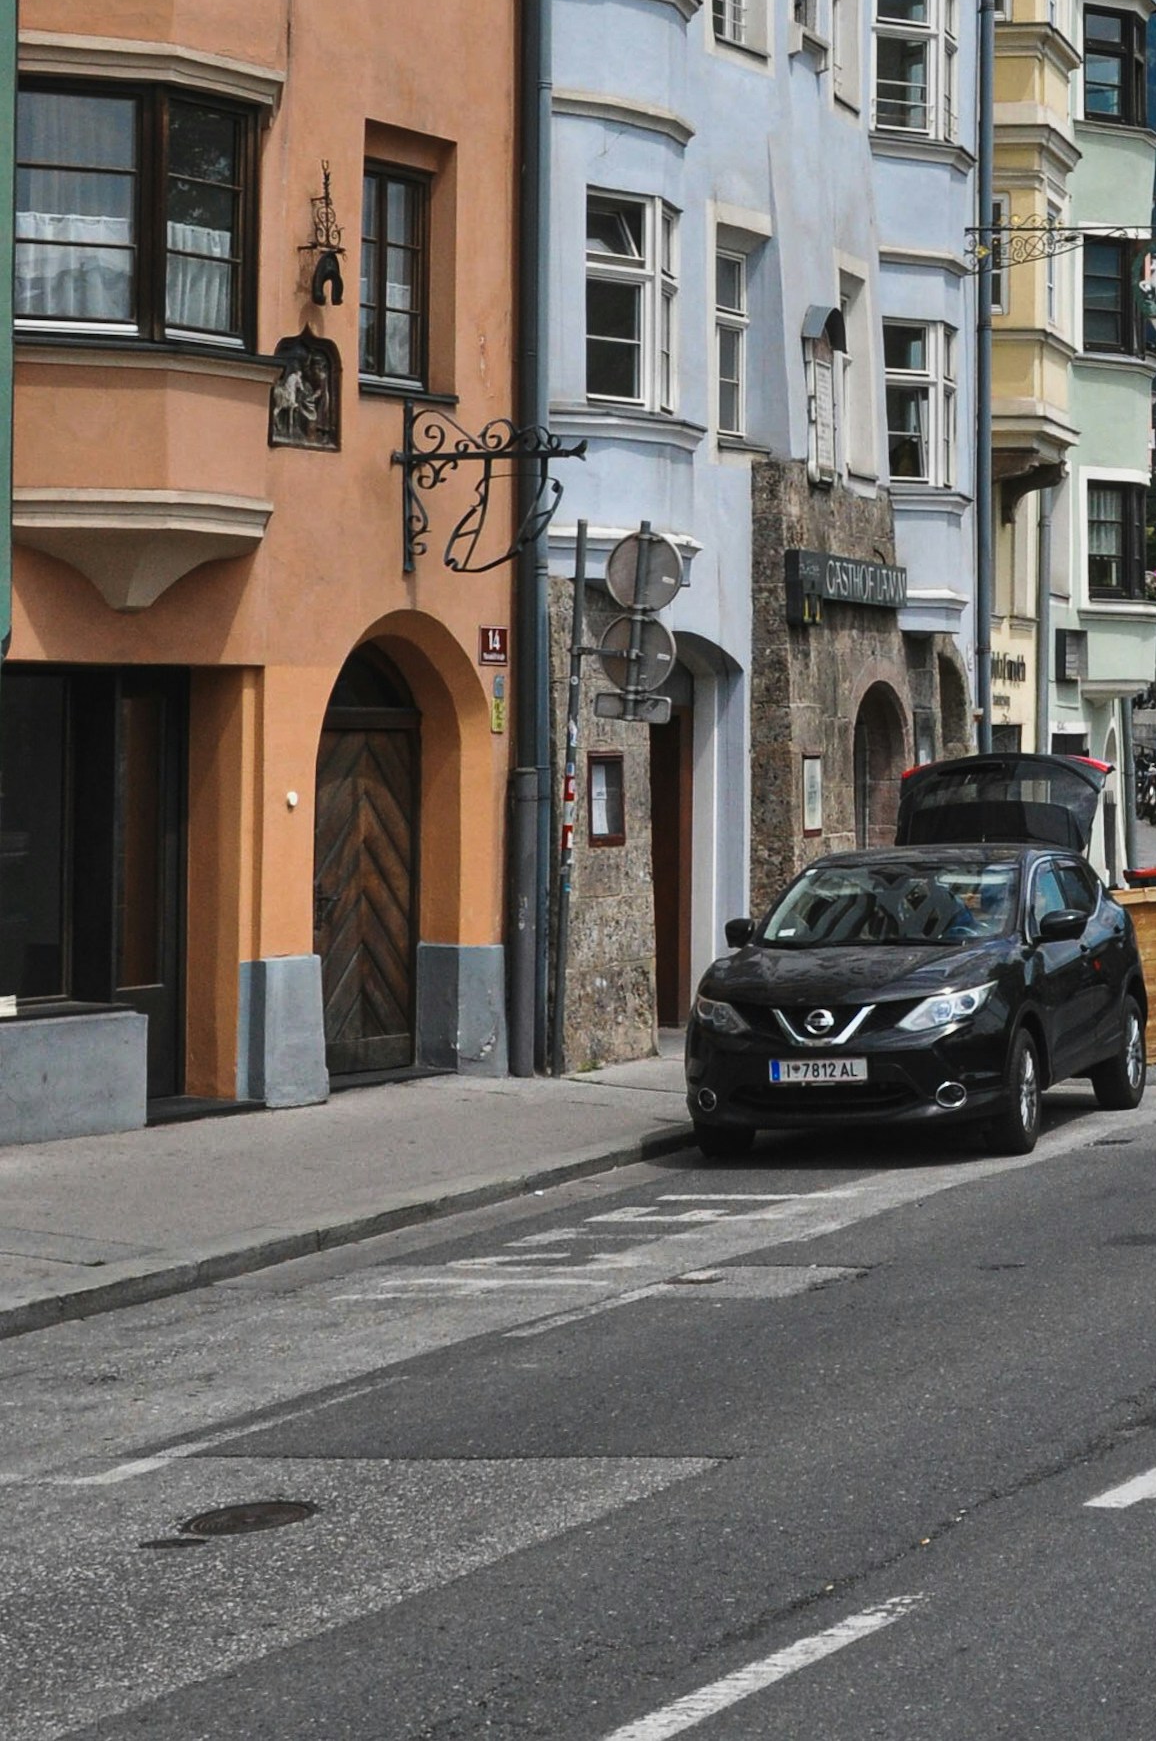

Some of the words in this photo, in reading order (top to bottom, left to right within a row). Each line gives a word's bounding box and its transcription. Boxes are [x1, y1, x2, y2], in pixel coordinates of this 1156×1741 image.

[826, 560, 875, 599] GASTHOF
[488, 629, 501, 650] 14
[802, 1062, 836, 1078] 7812
[840, 1062, 858, 1077] AL
